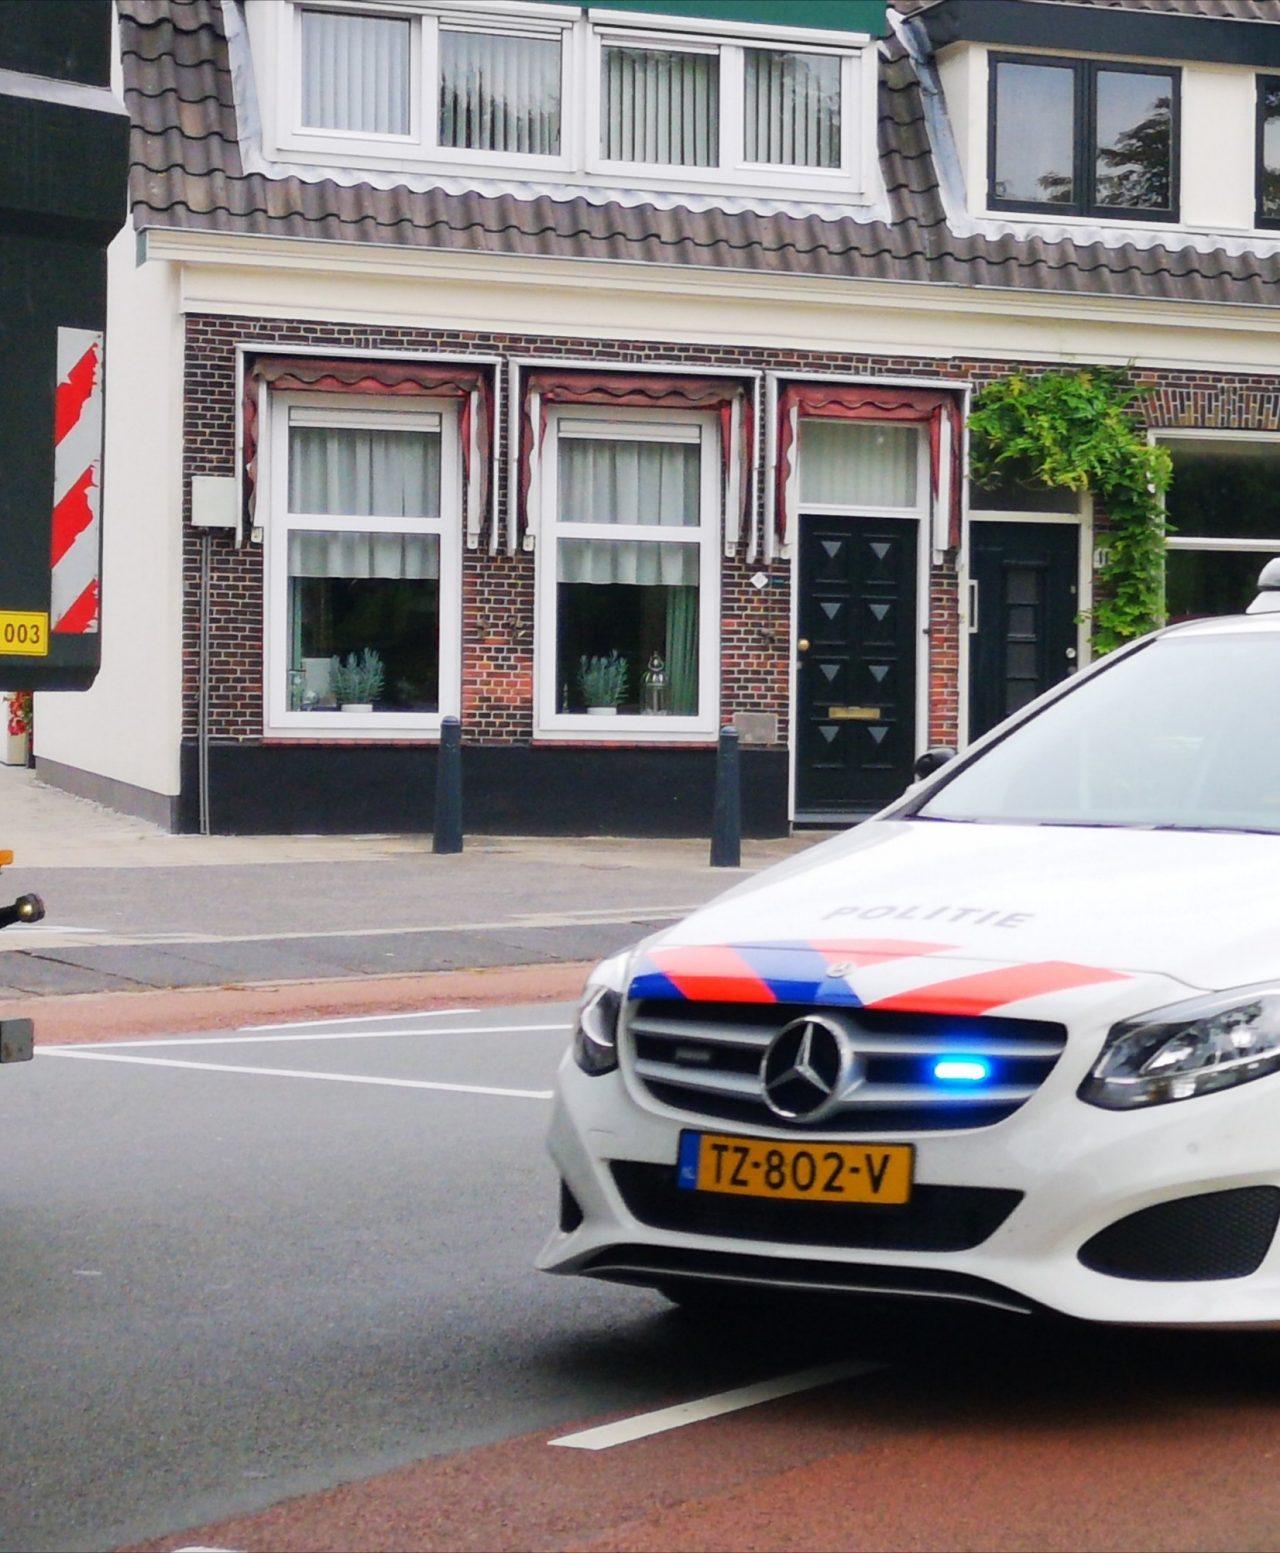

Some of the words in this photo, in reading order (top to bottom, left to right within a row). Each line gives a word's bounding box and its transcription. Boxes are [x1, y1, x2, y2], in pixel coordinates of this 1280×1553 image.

[4, 623, 40, 644] 003
[821, 904, 1036, 930] POLITIE
[710, 1143, 891, 1194] TZ-802-V
